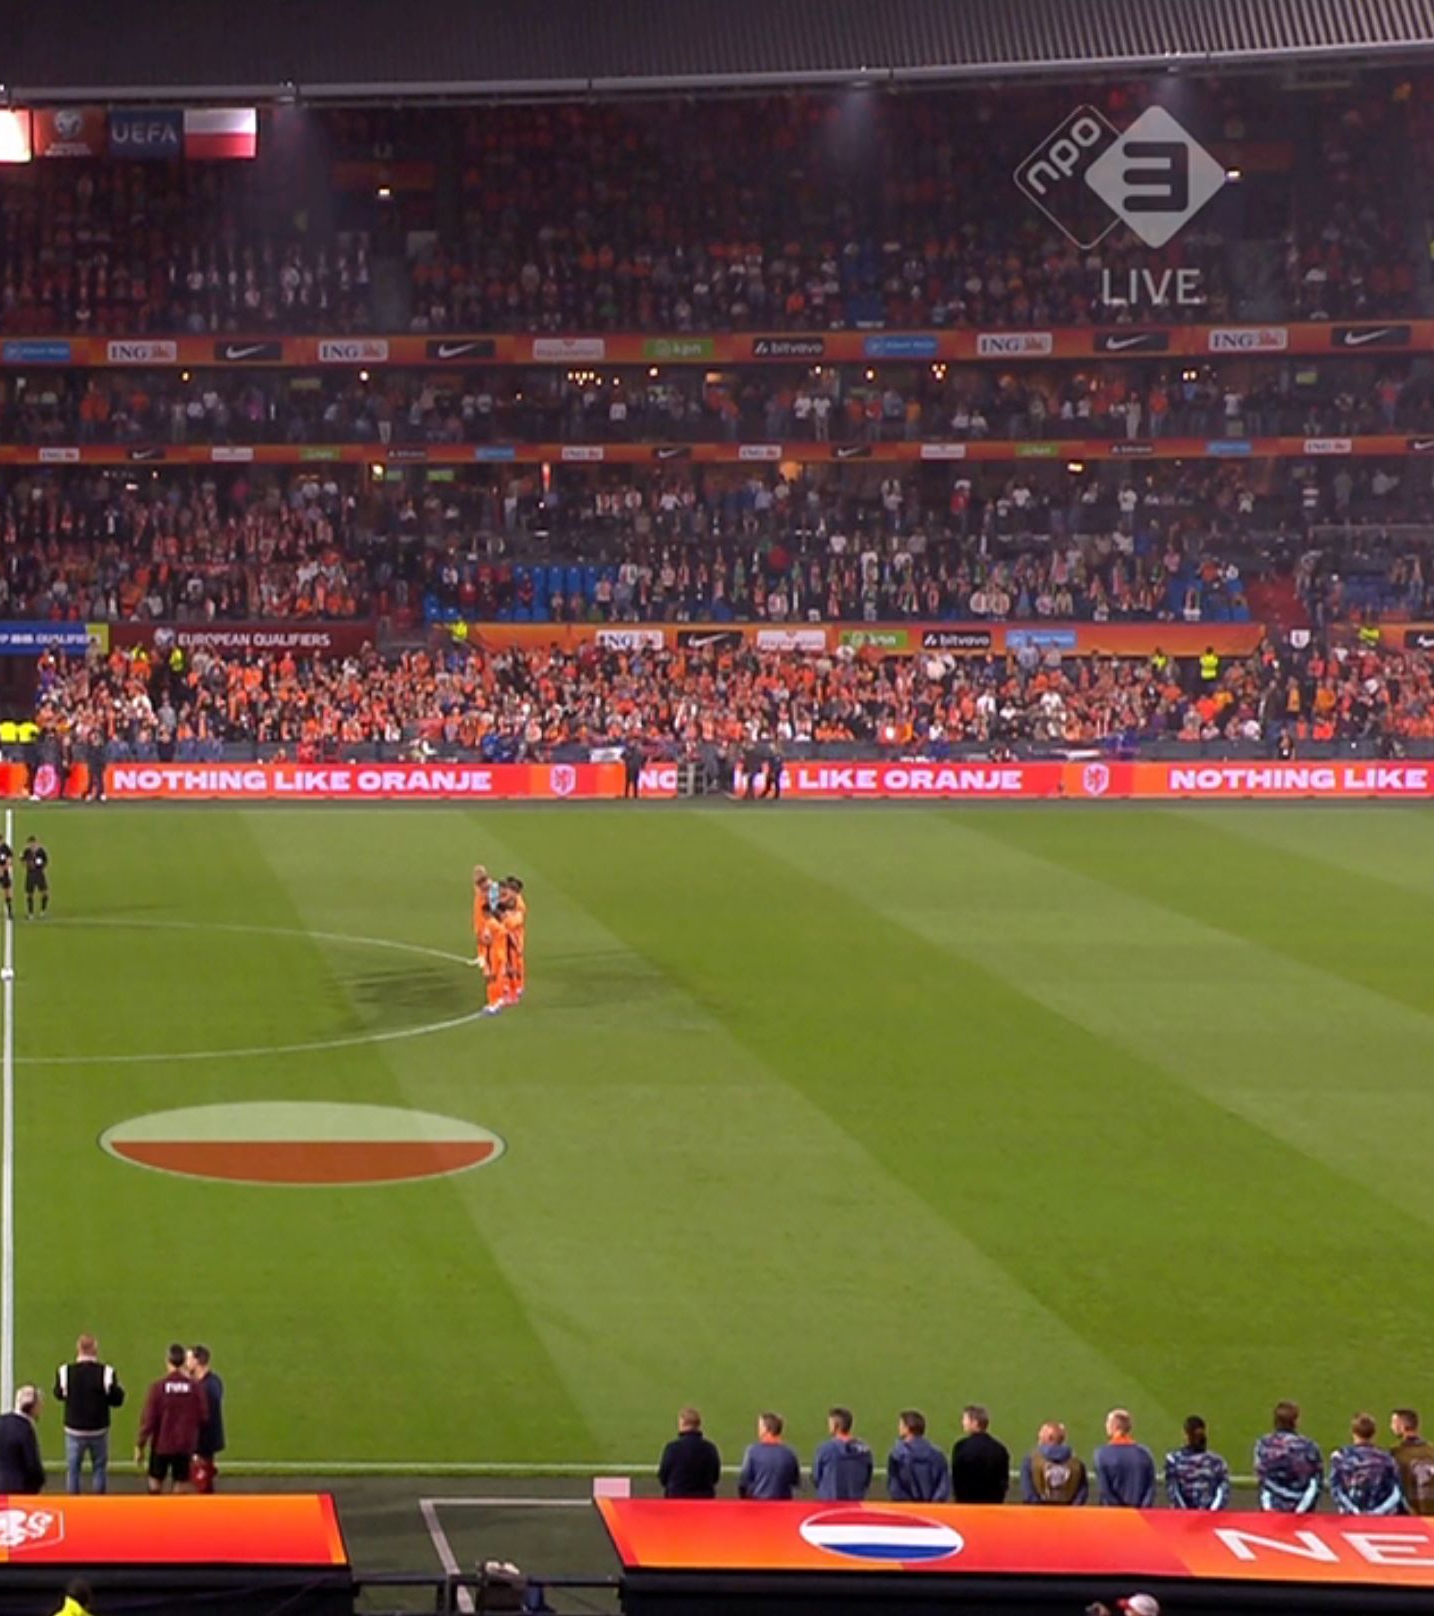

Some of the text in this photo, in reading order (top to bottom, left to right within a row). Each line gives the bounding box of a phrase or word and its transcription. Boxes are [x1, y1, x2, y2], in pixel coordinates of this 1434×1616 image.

[111, 122, 177, 143] UEFA
[770, 340, 824, 354] bitvavo
[981, 337, 1019, 352] ING
[1213, 334, 1252, 348] ING
[111, 344, 148, 359] ING
[321, 344, 359, 359] ING
[178, 632, 331, 646] EUROPEAN QUALIFIERS
[940, 633, 990, 646] bitvavo
[113, 770, 492, 791] NOTHING LIKE ORANJE
[798, 769, 877, 789] LIKE
[884, 769, 1023, 789] ORANJE
[1170, 768, 1428, 789] NOTHING LIKE
[1212, 1528, 1434, 1566] NE
